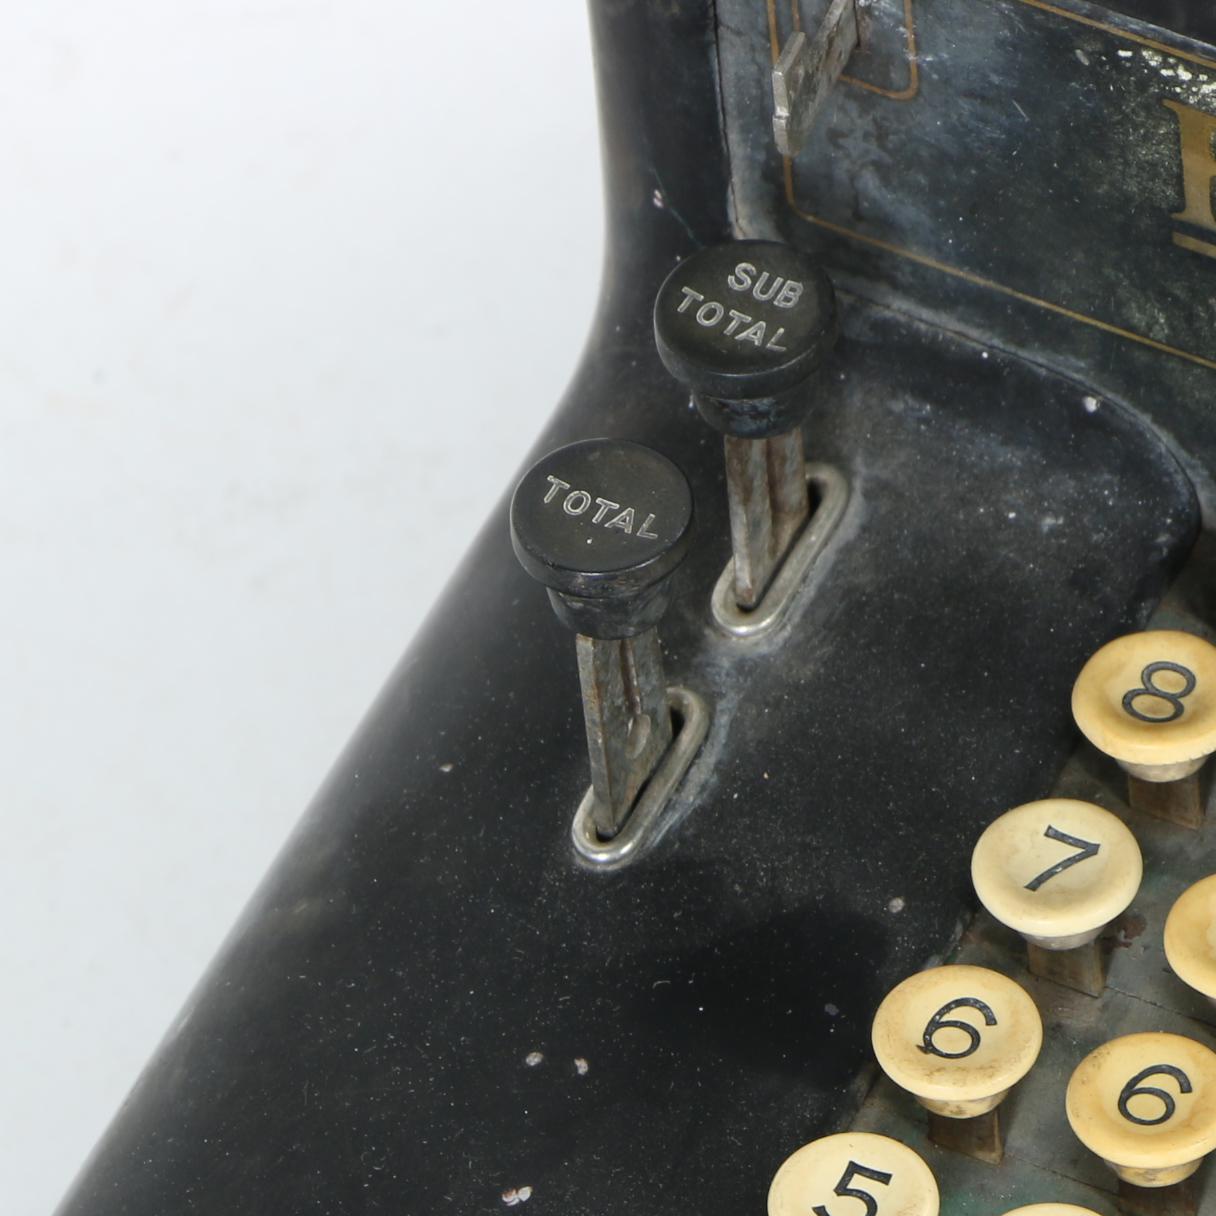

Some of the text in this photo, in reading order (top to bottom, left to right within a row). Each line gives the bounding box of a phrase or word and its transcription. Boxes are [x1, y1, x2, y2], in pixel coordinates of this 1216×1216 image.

[728, 263, 804, 308] SUB
[677, 286, 787, 351] TOTAL
[544, 475, 659, 539] TOTAL
[1122, 661, 1196, 730] 8
[1025, 825, 1099, 892] 7
[920, 998, 997, 1059] 6
[1117, 1065, 1192, 1126] 6
